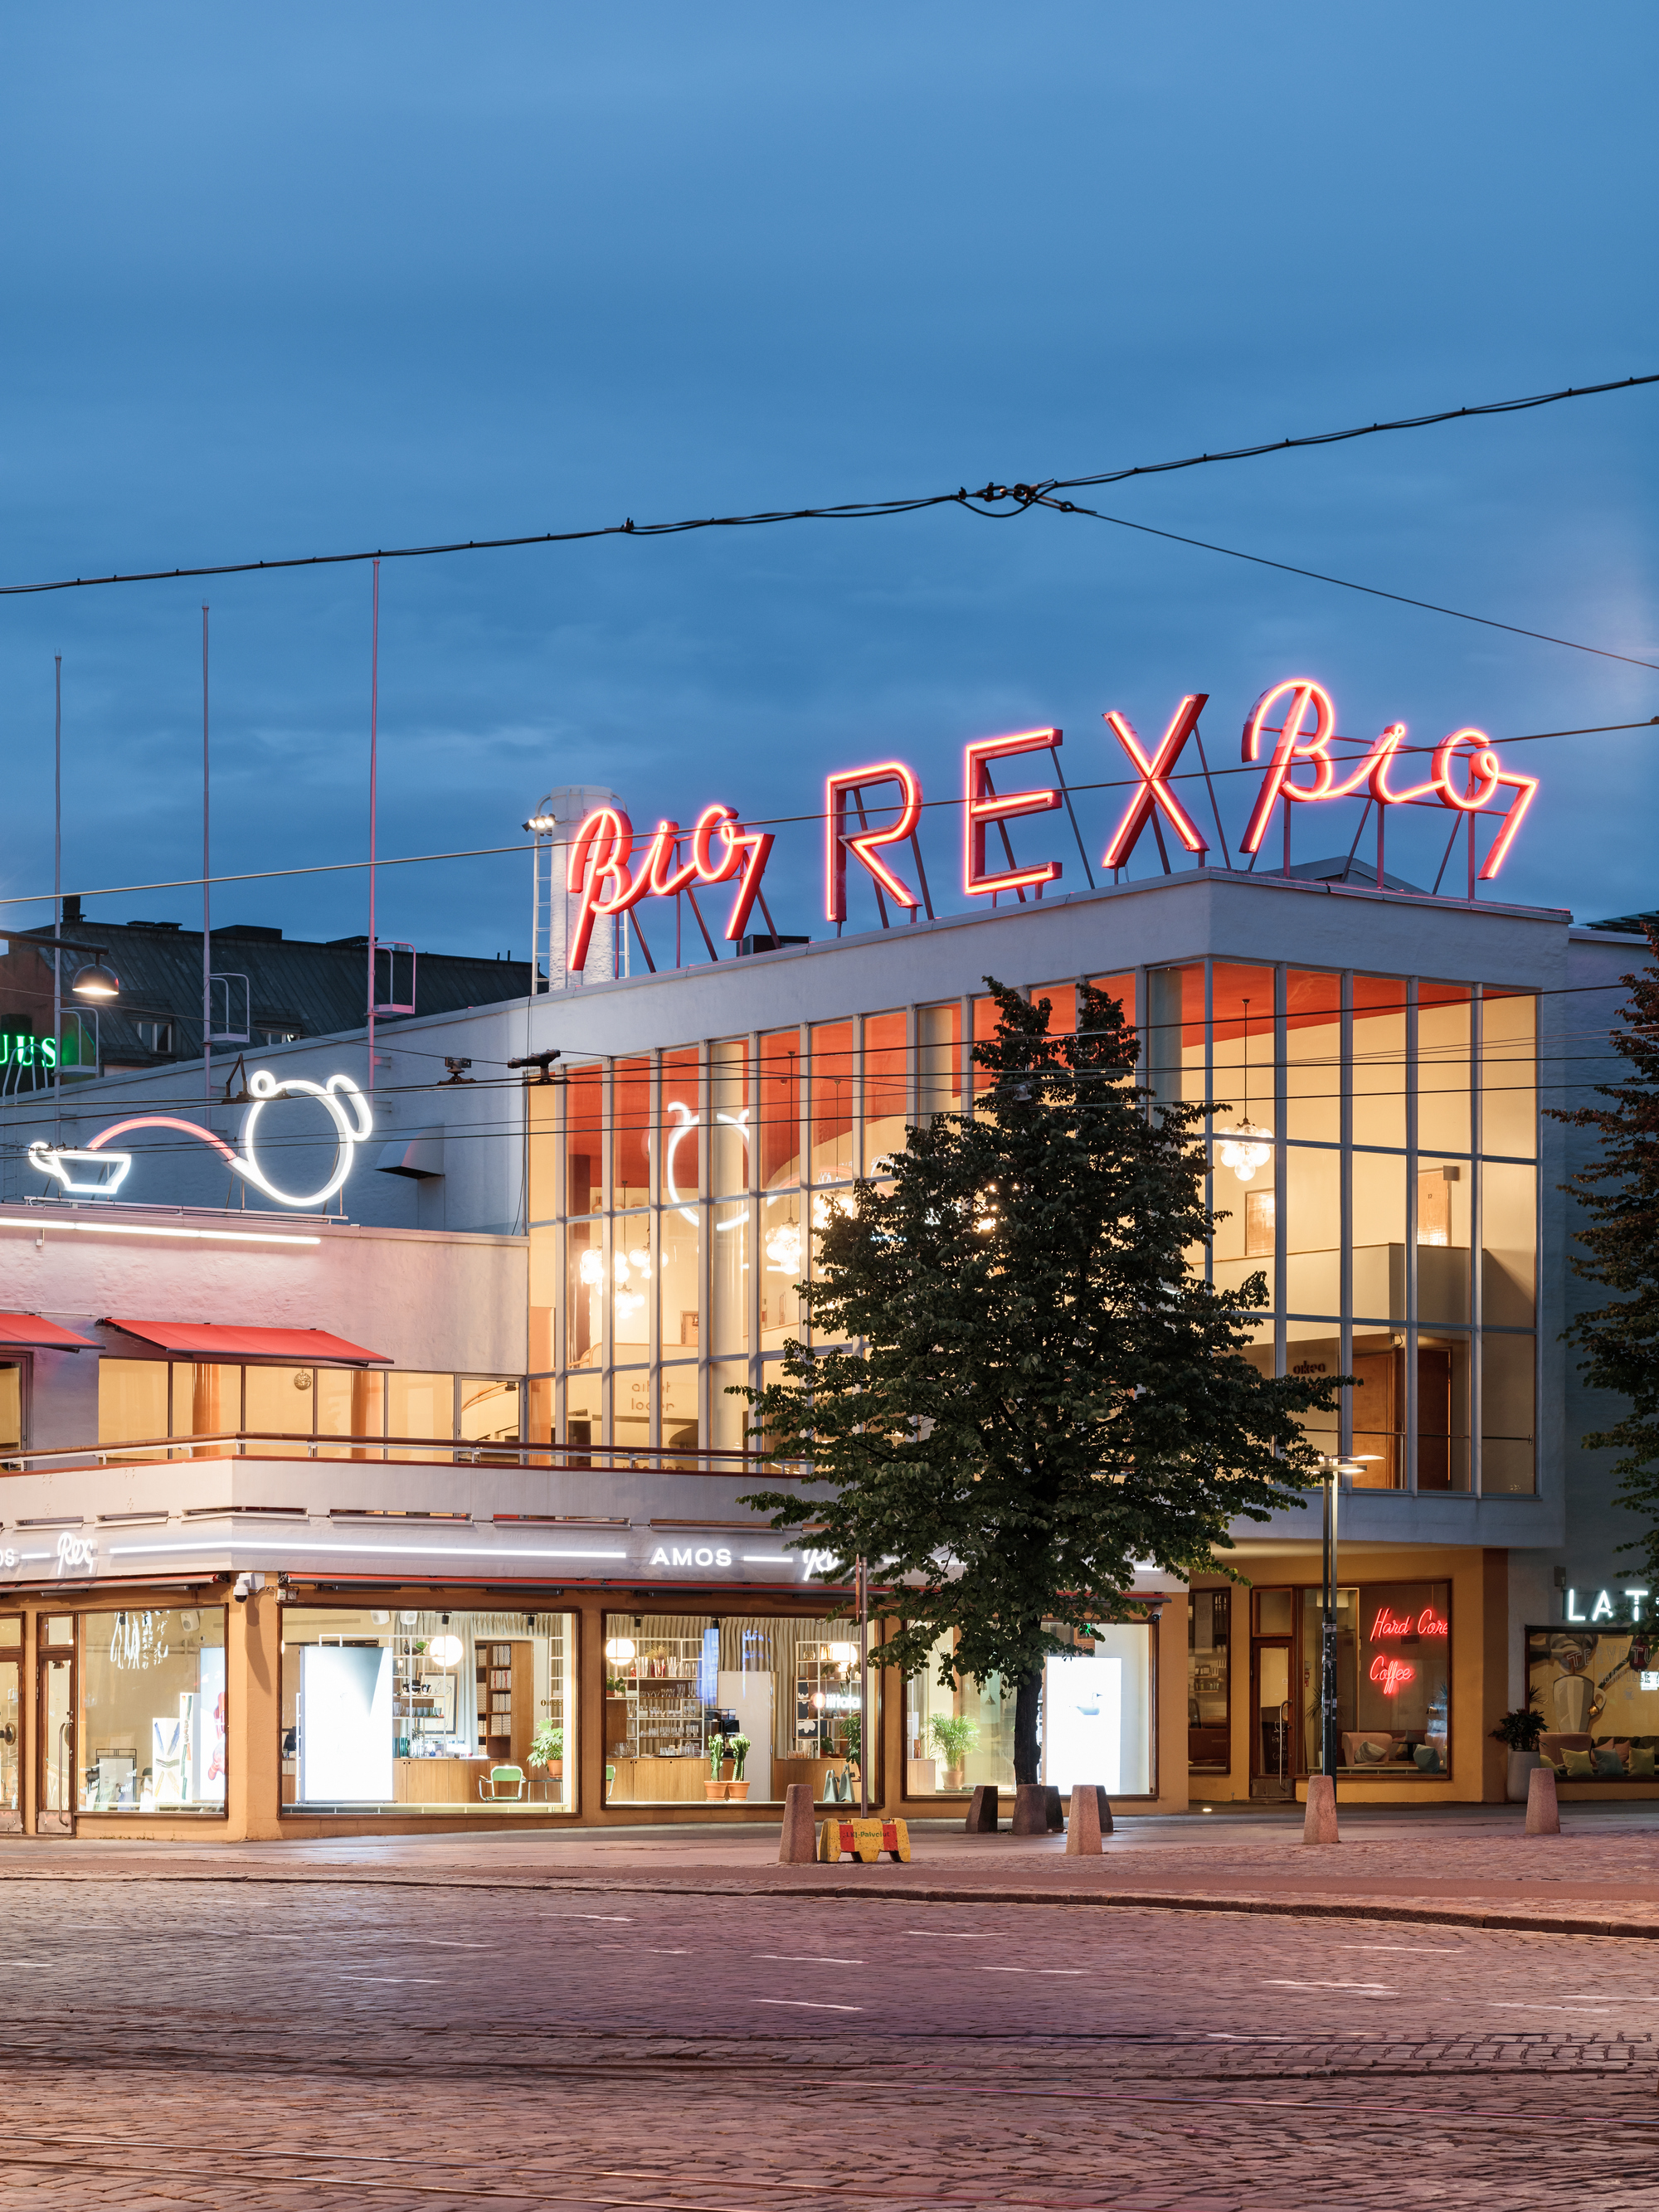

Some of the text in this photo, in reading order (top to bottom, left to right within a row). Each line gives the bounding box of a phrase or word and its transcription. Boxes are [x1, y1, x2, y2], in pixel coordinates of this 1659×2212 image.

[1239, 678, 1540, 880] Bio
[567, 693, 1209, 971] Bio REX
[57, 1531, 94, 1576] Rex
[650, 1548, 732, 1567] AMOS
[1568, 1588, 1659, 1621] LAT
[1370, 1607, 1447, 1642] Hard Core
[1370, 1655, 1412, 1694] Coffee
